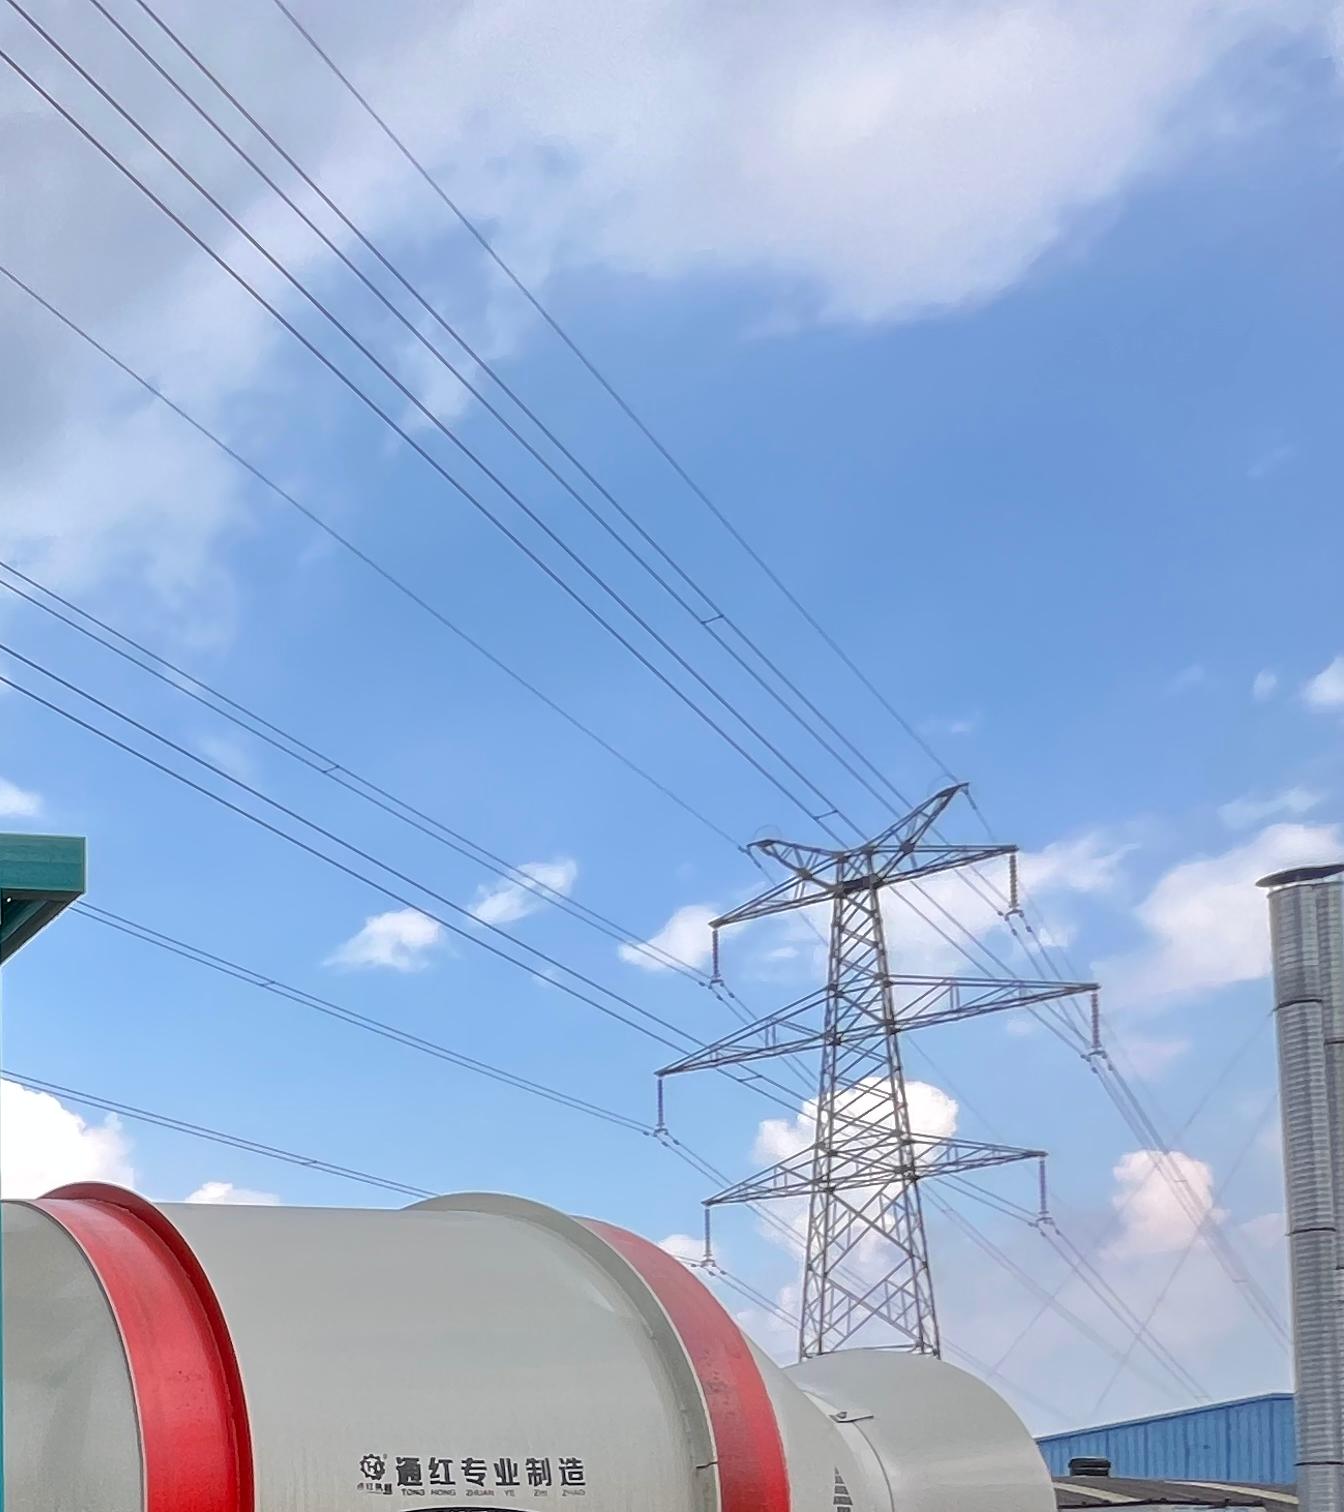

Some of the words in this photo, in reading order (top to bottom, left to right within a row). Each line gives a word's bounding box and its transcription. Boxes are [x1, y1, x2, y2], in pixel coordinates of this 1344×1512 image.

[396, 1457, 586, 1487] 通红专业制造
